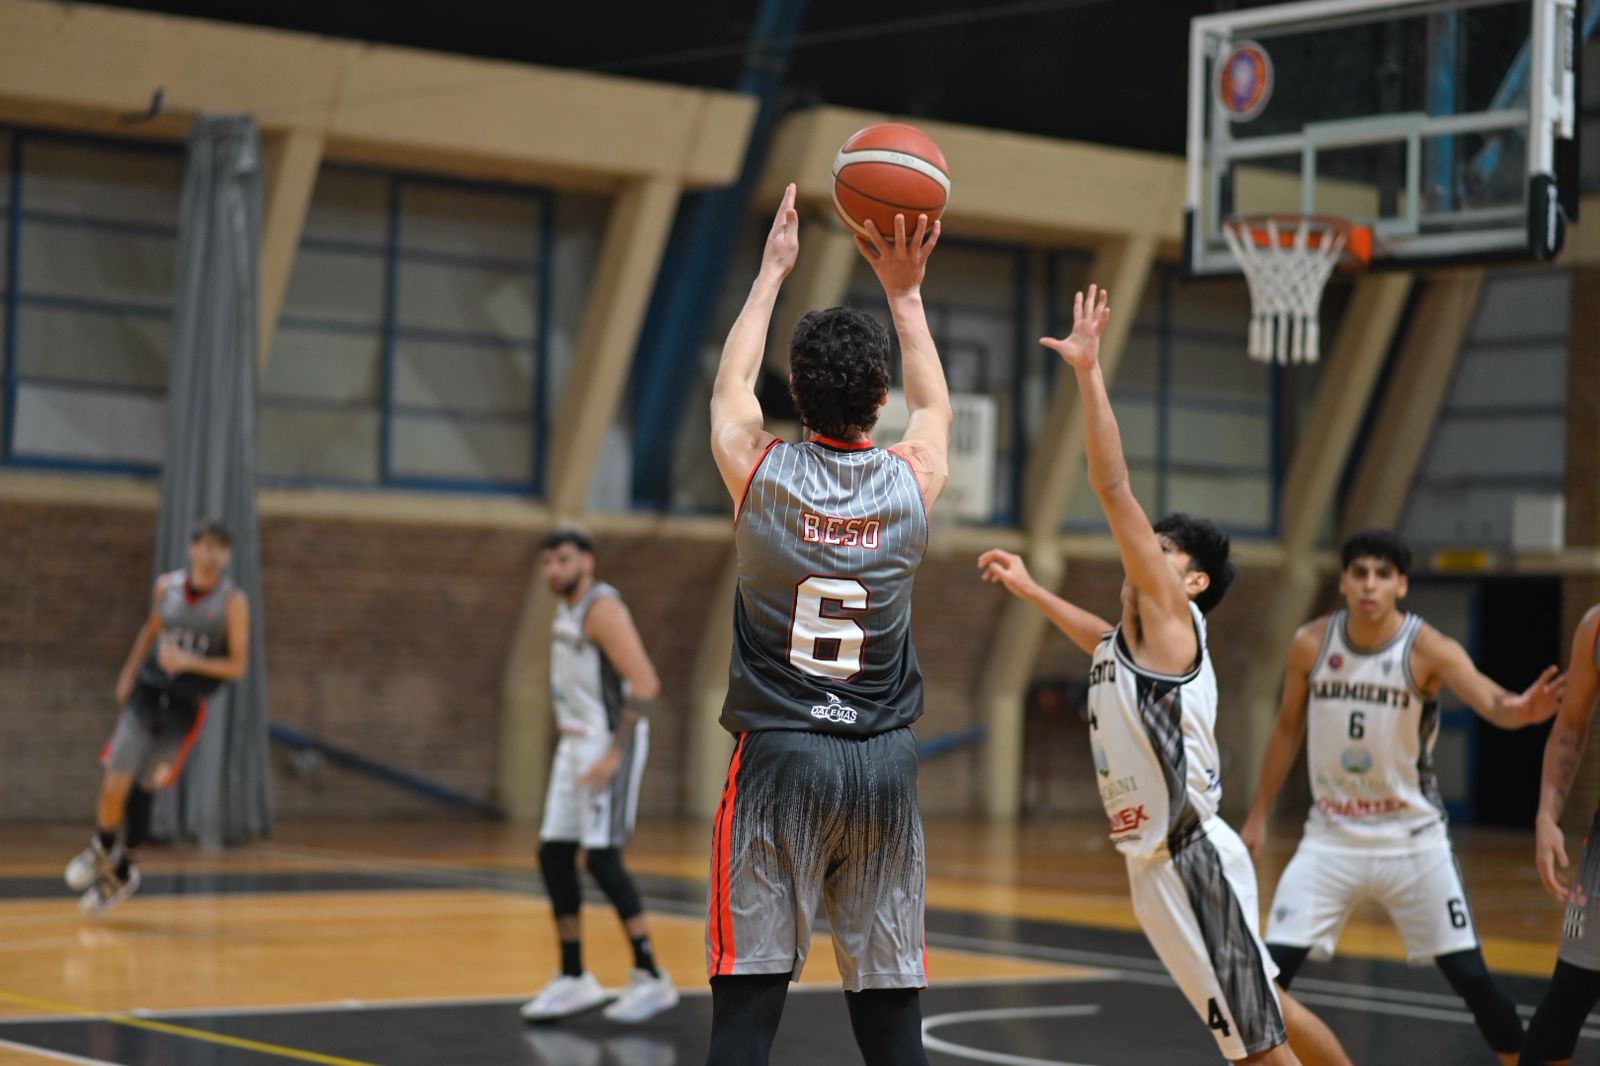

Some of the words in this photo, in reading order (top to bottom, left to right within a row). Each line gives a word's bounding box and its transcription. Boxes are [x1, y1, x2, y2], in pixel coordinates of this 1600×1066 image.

[802, 512, 881, 549] BESO
[786, 573, 872, 684] 6
[1349, 710, 1364, 740] 6
[1447, 899, 1466, 928] 6
[1207, 997, 1231, 1038] 4
